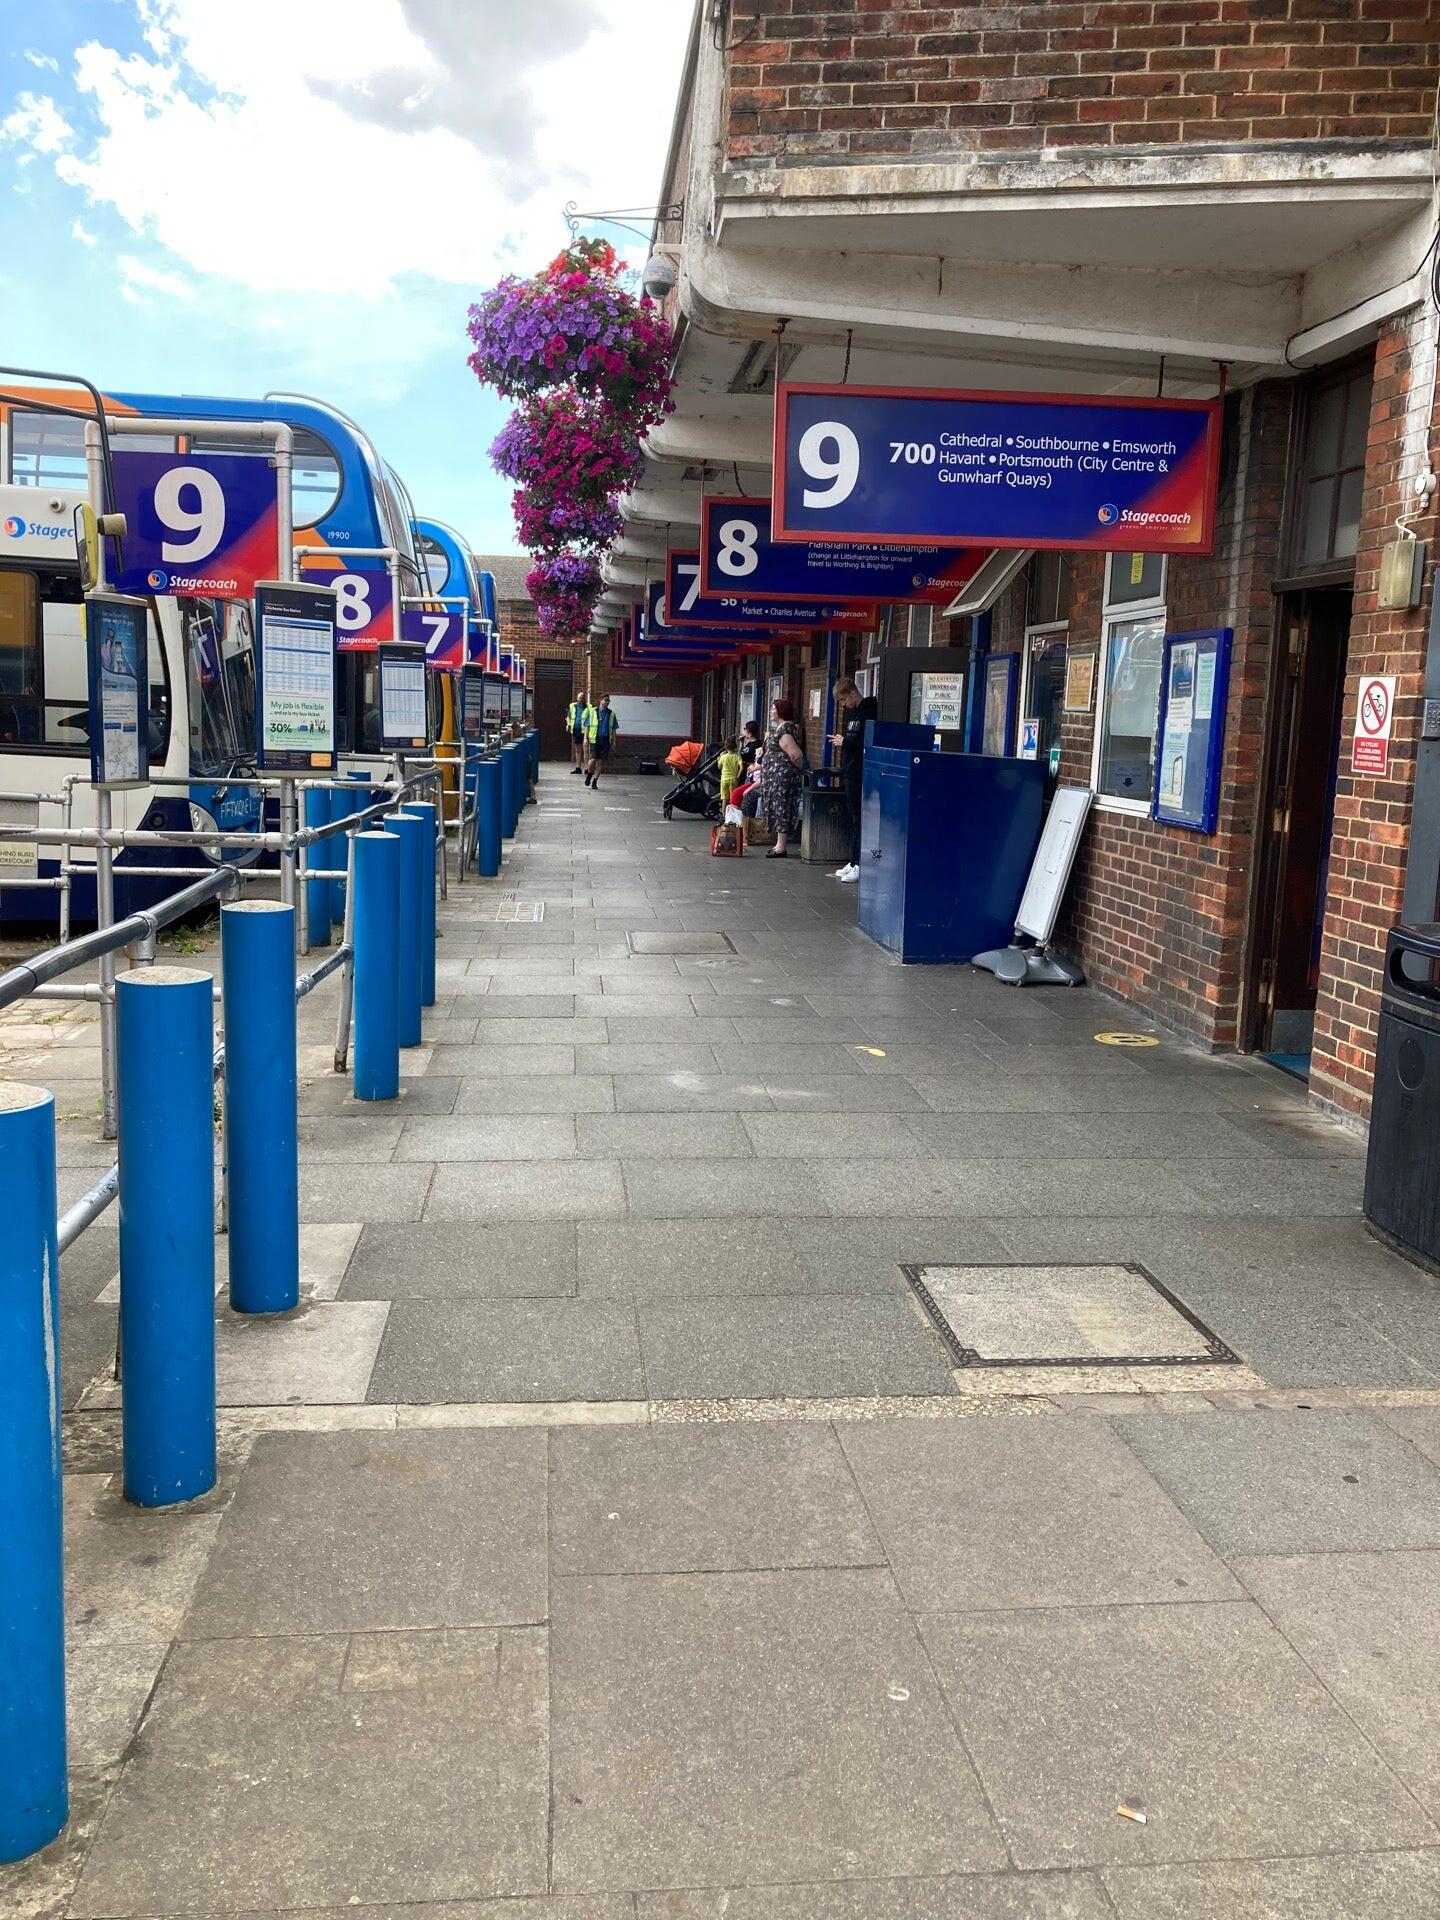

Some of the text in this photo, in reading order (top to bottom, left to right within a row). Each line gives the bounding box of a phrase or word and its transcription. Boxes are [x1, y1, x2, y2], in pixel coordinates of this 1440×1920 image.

[889, 443, 935, 464] 700
[940, 432, 1176, 454] Cathedral Southbourne Emsworth
[799, 421, 860, 509] 9
[940, 451, 1168, 472] Havant Portsmouth (City Centre &
[938, 470, 1052, 488] Gunwharf Quays)
[154, 466, 226, 563] 9
[1120, 510, 1190, 525] Stagecoach
[28, 523, 74, 540] Stagec
[328, 532, 350, 540] 19900
[716, 520, 758, 576] 8
[170, 576, 238, 590] Stagecoach
[677, 564, 700, 610] 7
[330, 574, 372, 630] 8
[339, 636, 378, 645] Stagecoach
[422, 616, 450, 654] 7
[270, 722, 292, 734] 30%
